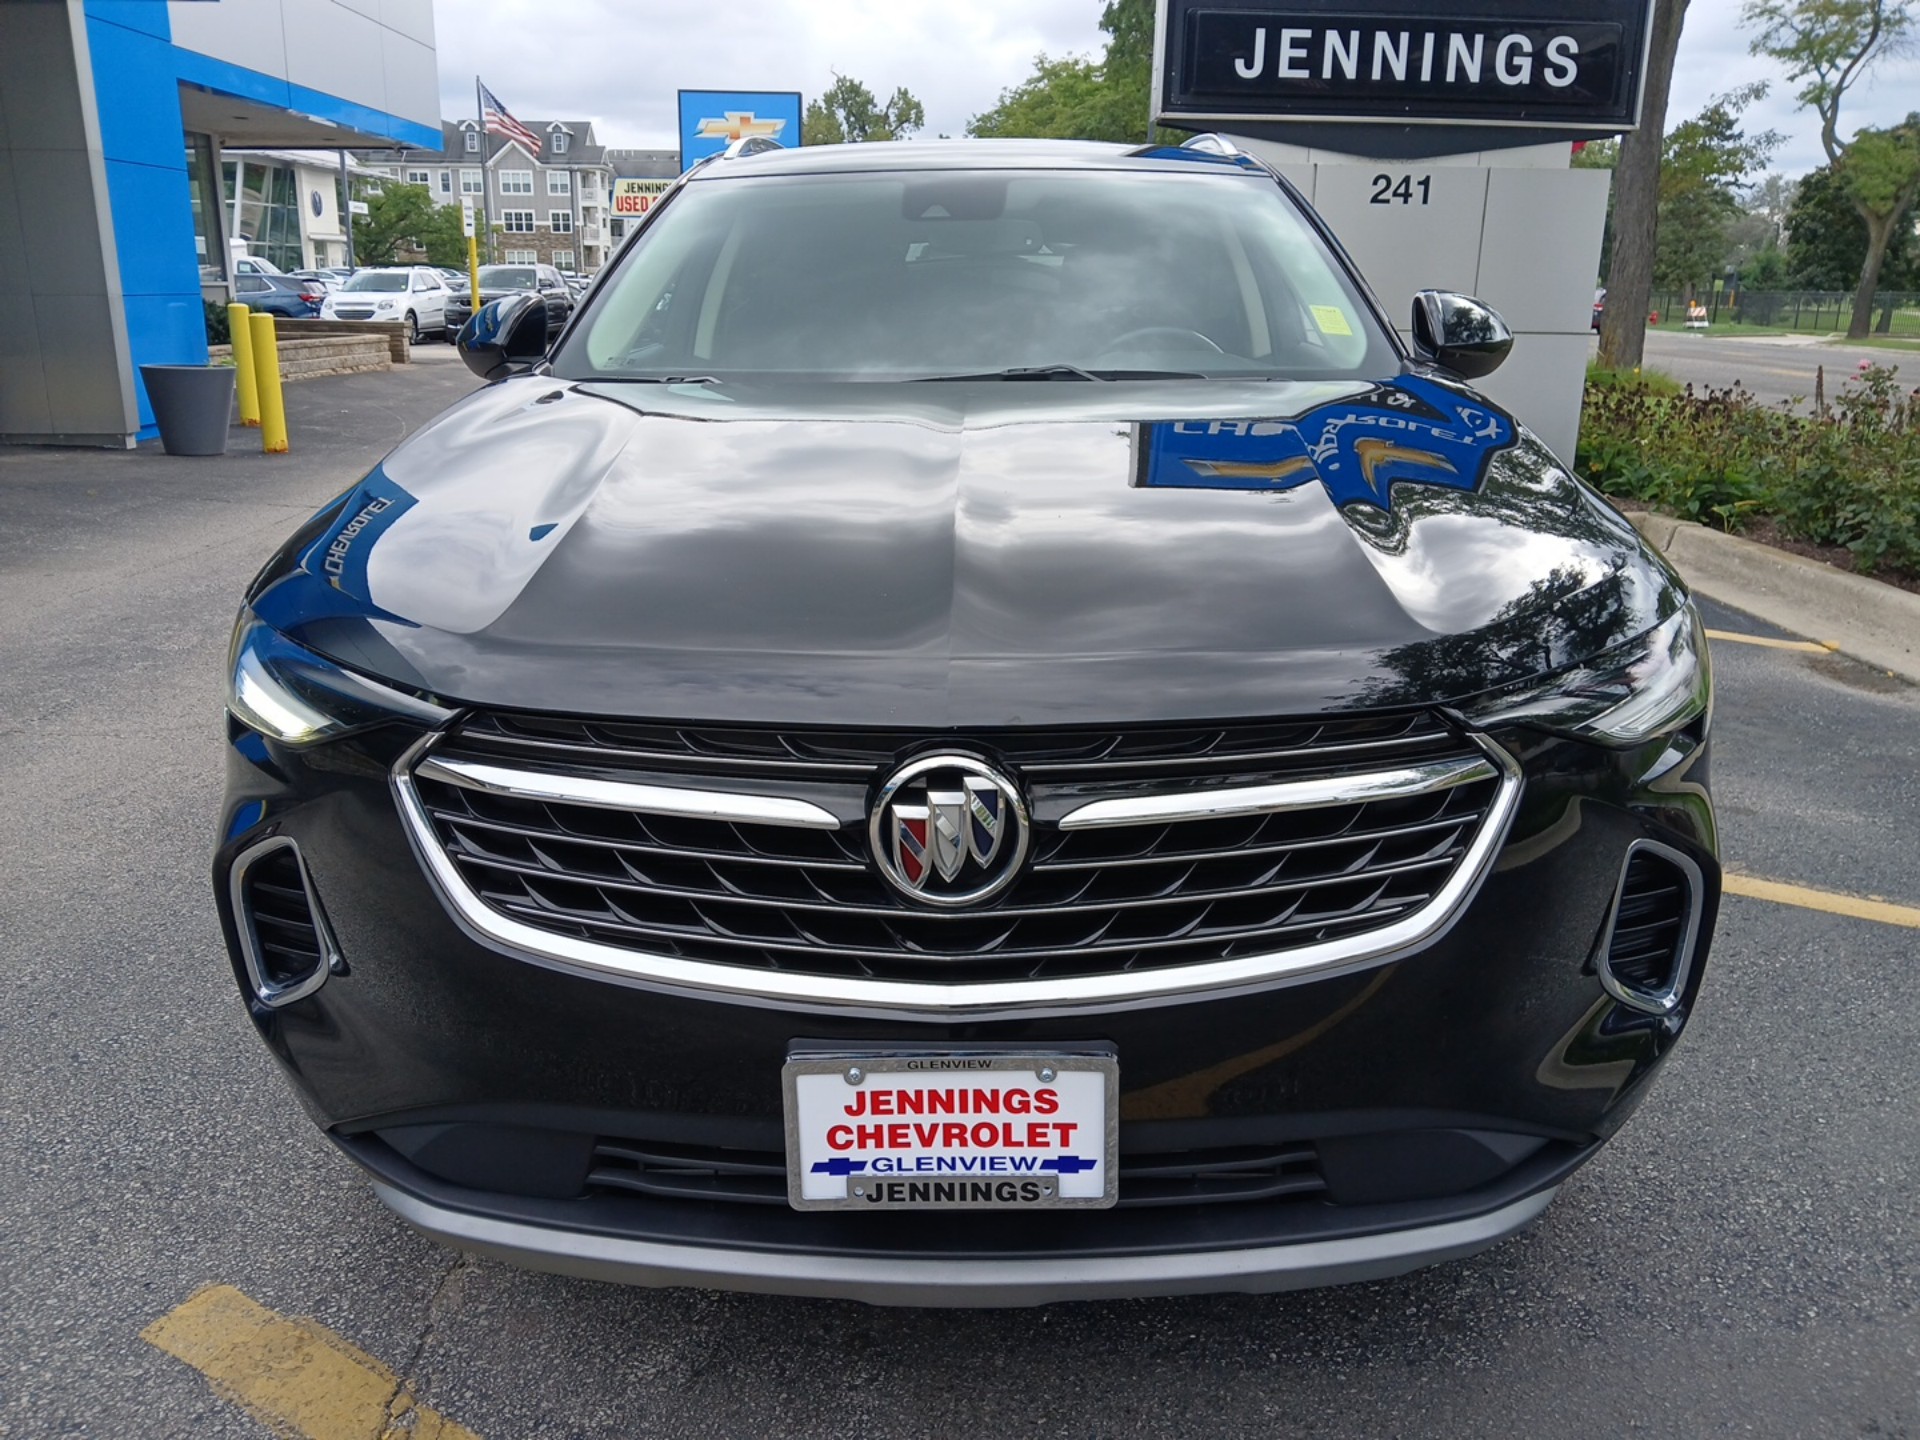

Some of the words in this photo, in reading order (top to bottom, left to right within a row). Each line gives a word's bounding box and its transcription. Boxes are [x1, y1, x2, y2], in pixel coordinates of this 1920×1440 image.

[1234, 26, 1580, 89] JENNINGS
[624, 182, 672, 194] JENNING
[1370, 173, 1431, 205] 241
[615, 195, 649, 212] USED
[907, 1059, 993, 1070] GLENVIEW
[843, 1088, 1060, 1117] JENNINGS
[825, 1121, 1079, 1150] CHEVROLET
[870, 1156, 1040, 1173] GLENVIEW
[866, 1181, 1042, 1203] JENNINGS
